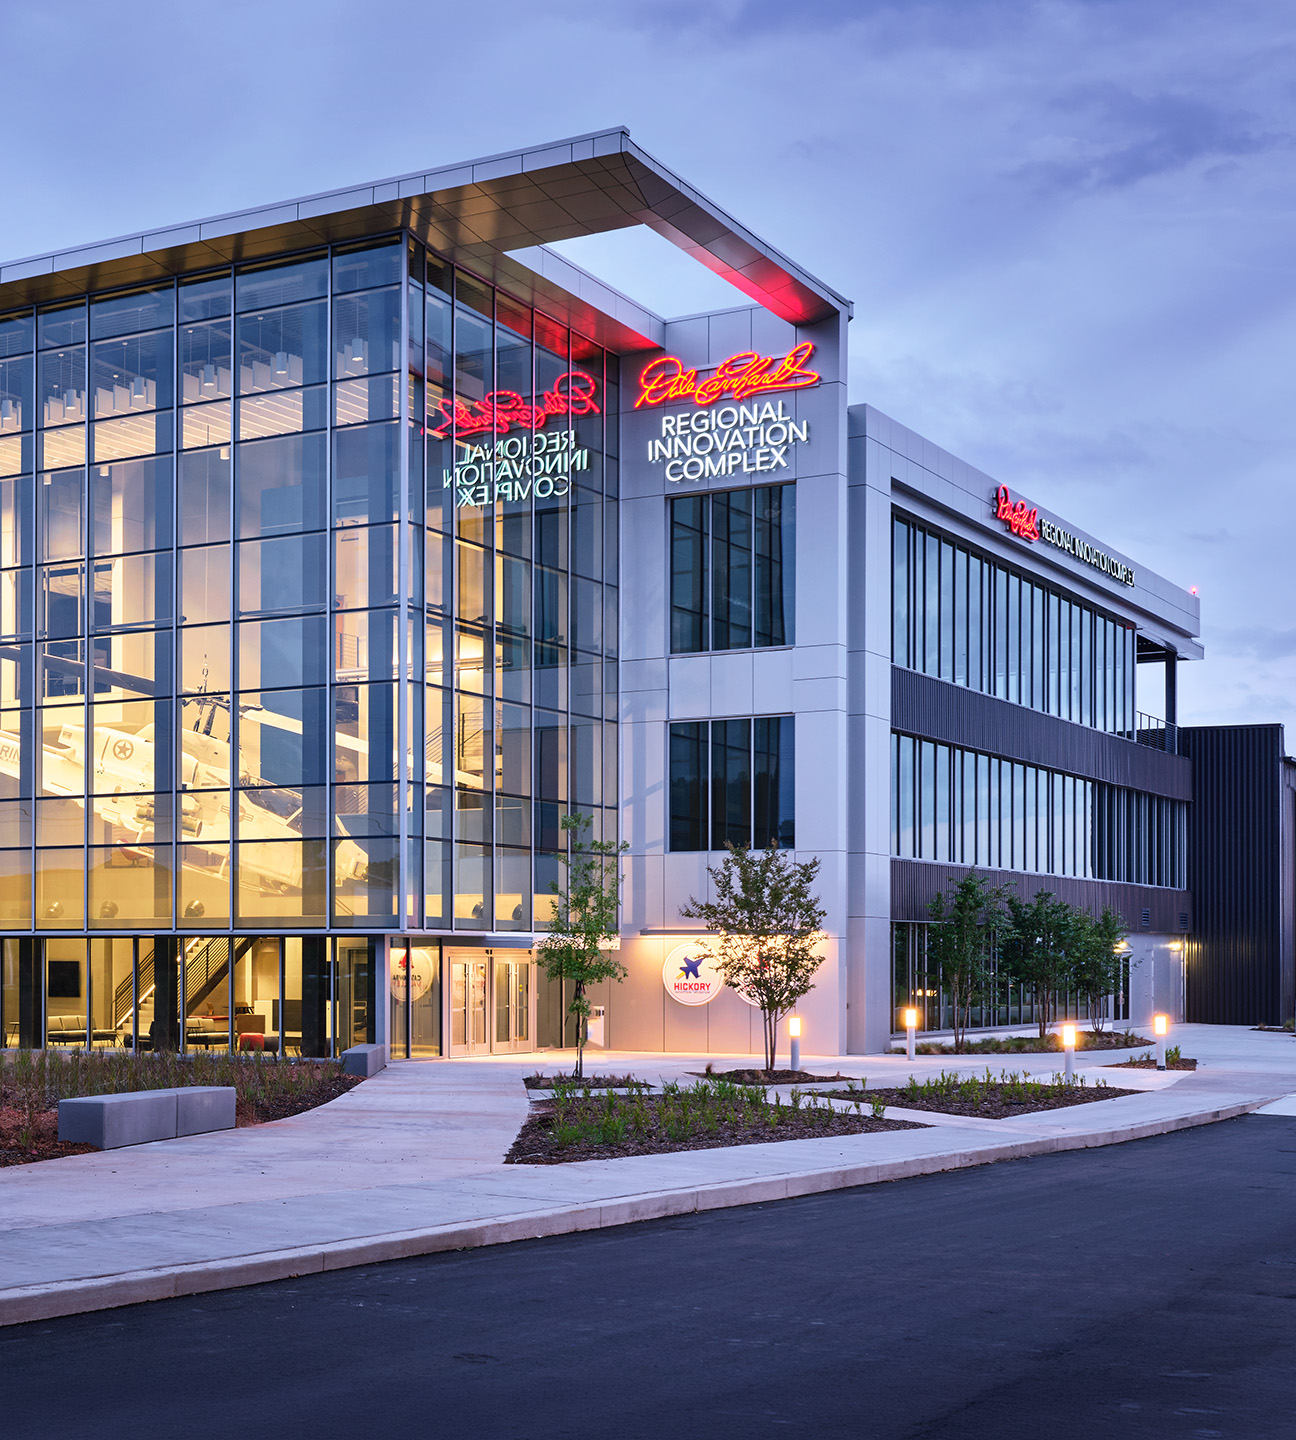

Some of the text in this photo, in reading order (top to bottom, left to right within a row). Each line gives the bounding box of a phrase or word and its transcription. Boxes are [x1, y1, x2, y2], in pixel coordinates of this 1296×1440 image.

[635, 356, 697, 408] Dale
[662, 400, 791, 438] REGIONAL
[648, 420, 808, 461] INNOVATION
[665, 446, 788, 482] COMPLEX
[1042, 518, 1075, 554] REGIONAL
[1075, 538, 1110, 572] INNOVATION
[1110, 557, 1136, 586] COMPLEX
[674, 982, 711, 991] HICKORY
